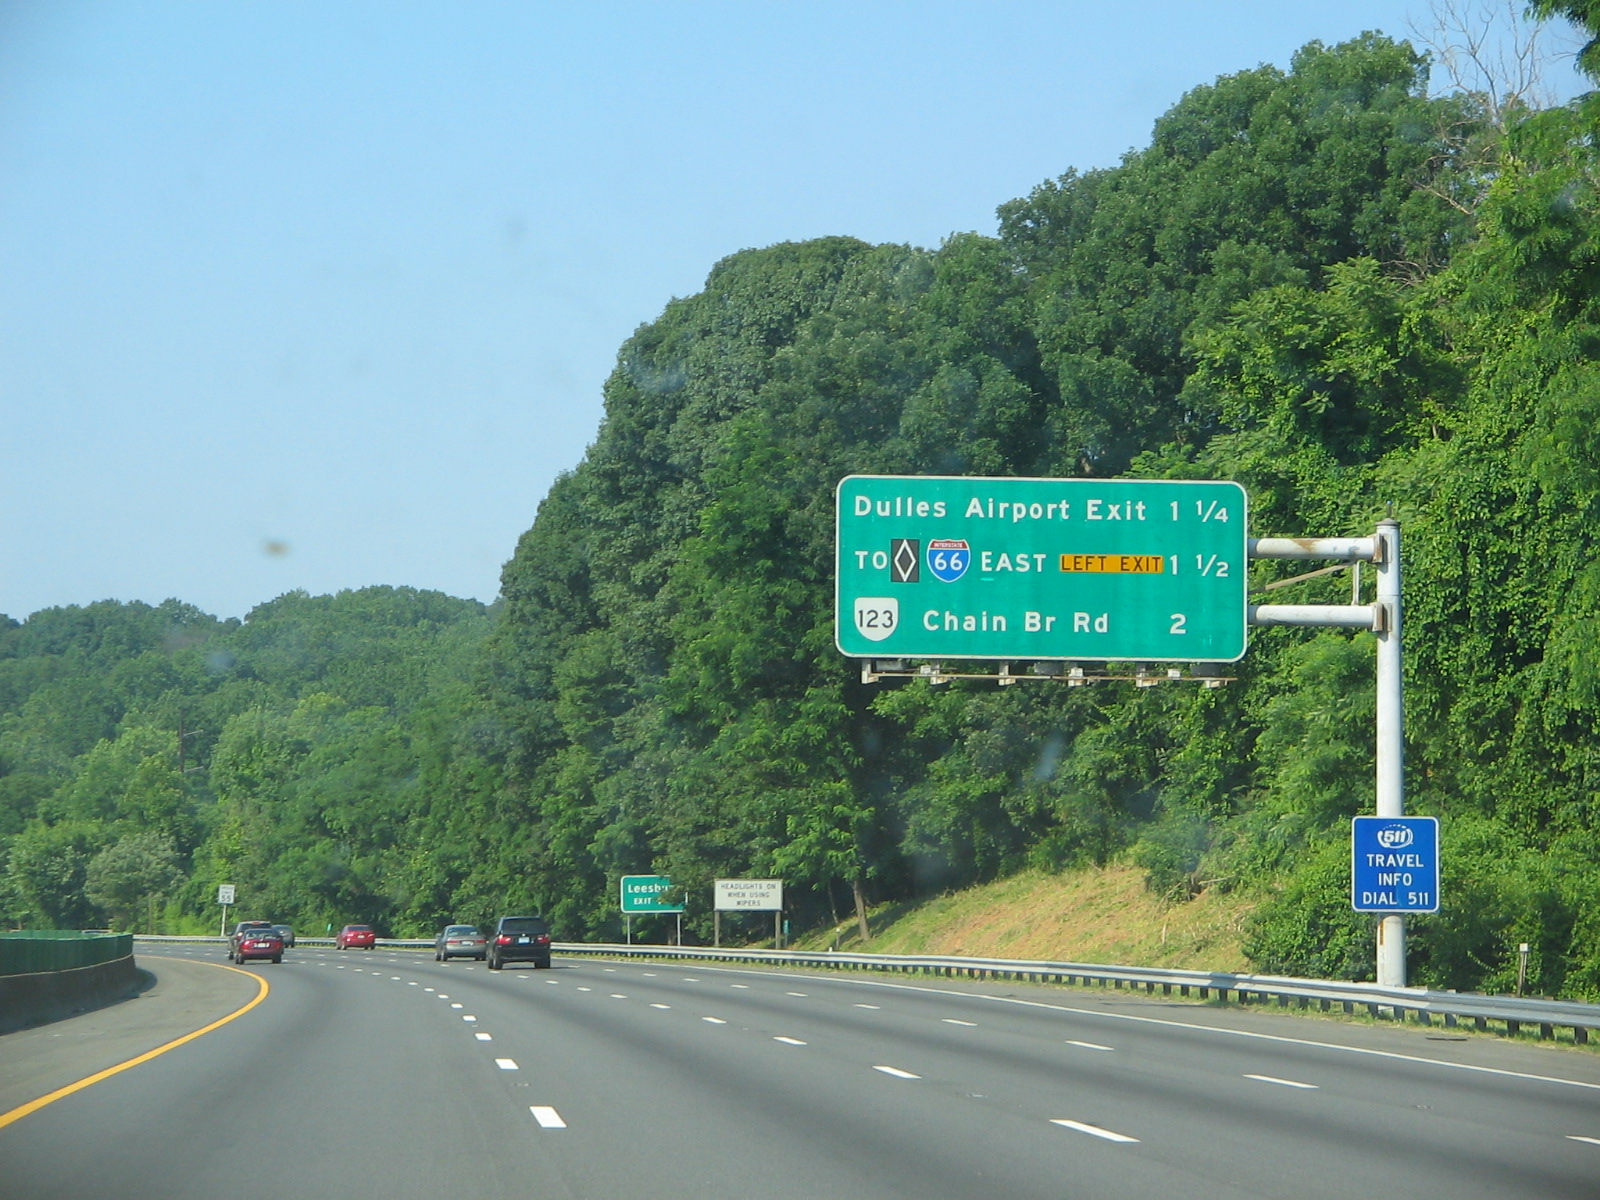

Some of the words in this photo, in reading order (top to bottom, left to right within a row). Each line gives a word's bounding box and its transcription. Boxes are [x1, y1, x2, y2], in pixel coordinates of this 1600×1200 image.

[854, 495, 947, 518] Dulles
[964, 497, 1070, 523] Airport
[1086, 499, 1146, 521] Exit
[1170, 500, 1179, 522] 1
[855, 550, 888, 570] TO
[934, 552, 963, 571] 66
[981, 551, 1046, 572] EAST
[1061, 555, 1107, 571] LEFT
[1120, 556, 1161, 572] EXIT
[1170, 554, 1179, 576] 1
[857, 609, 894, 628] 123
[923, 610, 1007, 632] Chain
[1024, 612, 1056, 632] Br
[1073, 613, 1109, 633] Rd
[1169, 614, 1186, 634] 2
[1383, 830, 1407, 843] 511
[1366, 854, 1424, 867] TRAVEL
[1378, 873, 1412, 886] INFO
[1362, 892, 1397, 905] DIAL
[1408, 892, 1429, 905] 511
